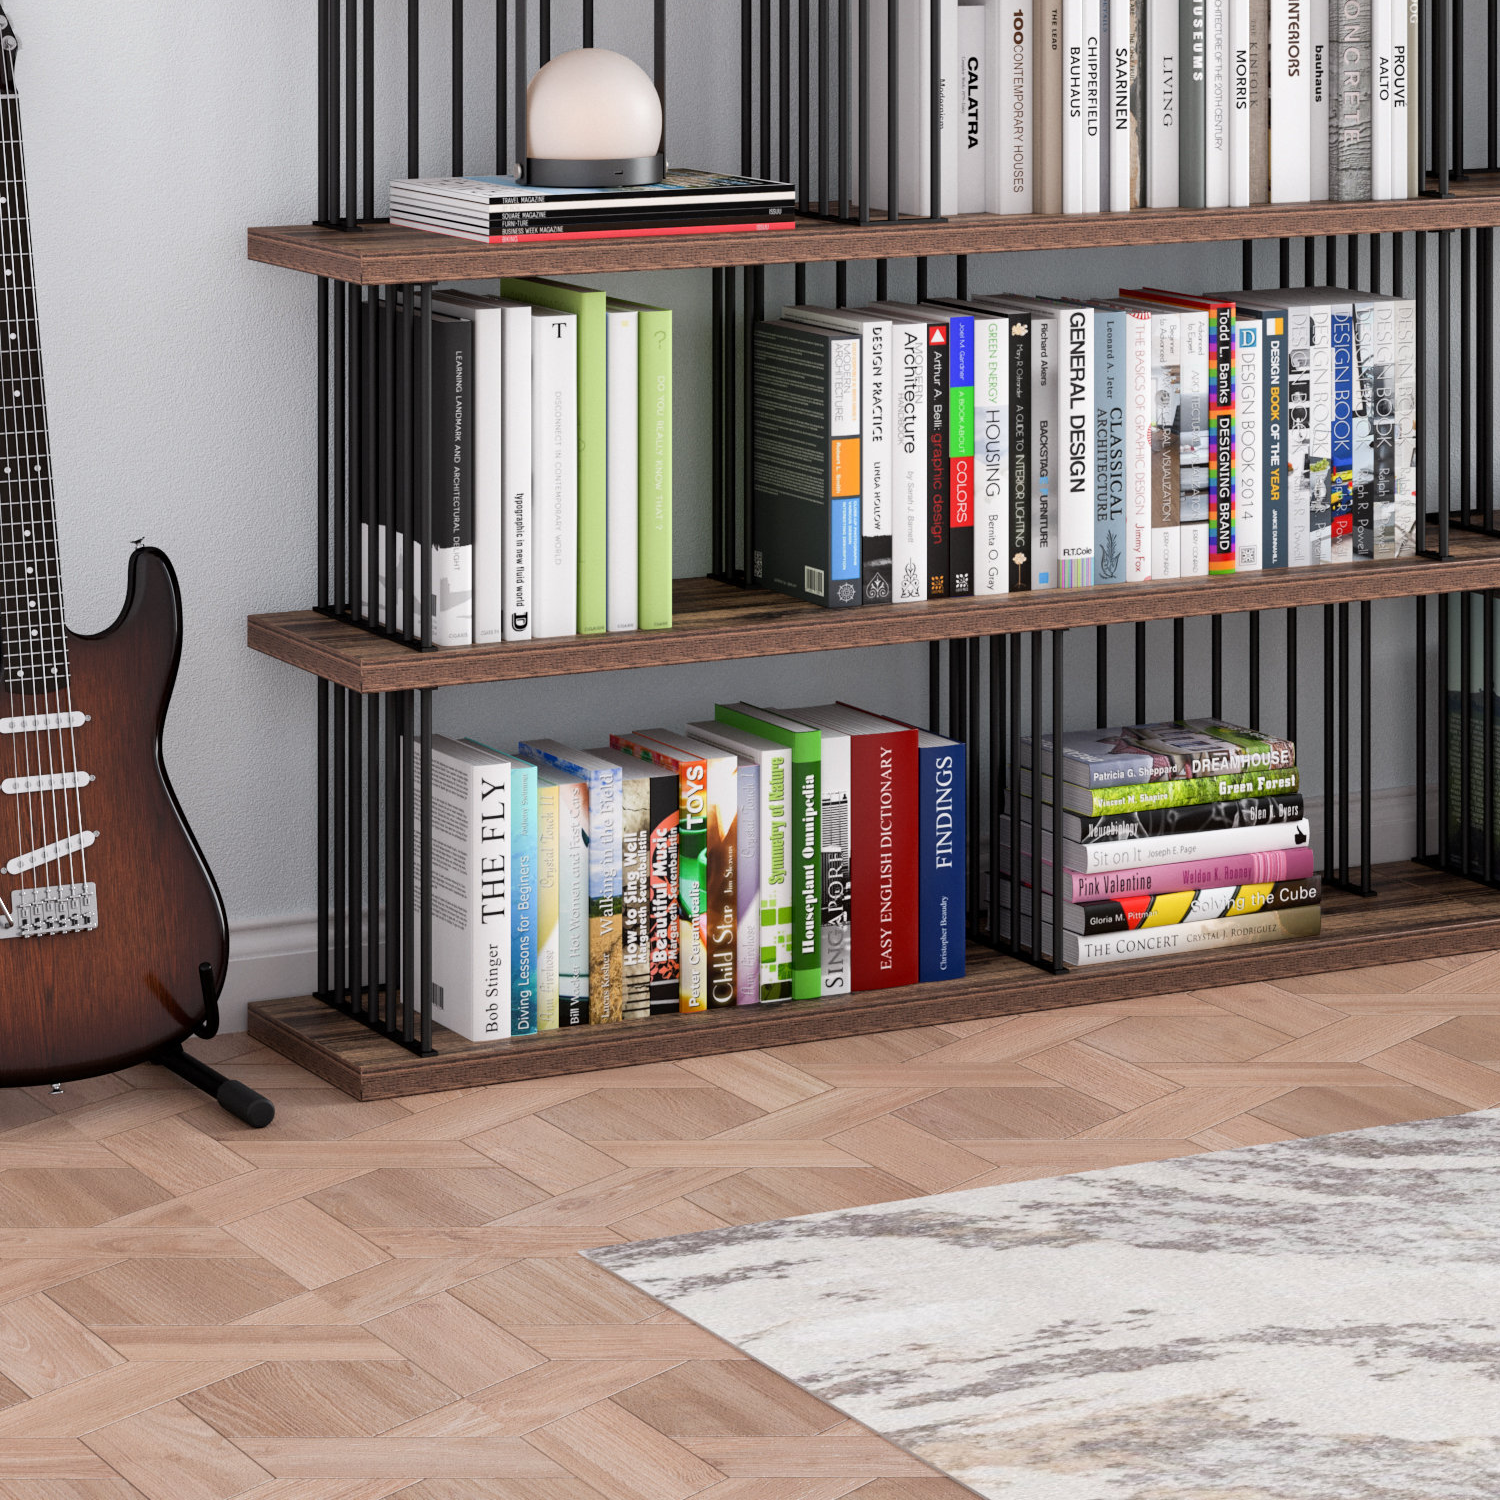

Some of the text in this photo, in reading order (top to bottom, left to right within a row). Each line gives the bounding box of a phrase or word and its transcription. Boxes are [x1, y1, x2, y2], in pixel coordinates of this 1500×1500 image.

[967, 56, 979, 149] CALATRA
[1070, 46, 1080, 118] BAUHAUS
[1087, 36, 1098, 137] CHIPPERFIELD
[1116, 48, 1128, 130] SAARINEN
[1163, 56, 1173, 127] LIVING
[1236, 50, 1247, 110] MORRIS
[1315, 45, 1324, 103] bauhaus
[1379, 56, 1389, 101] AALTO
[502, 210, 546, 220] SQUARE MAGAZINE
[521, 195, 545, 203] MAGAZINE
[1013, 145, 1024, 193] HOUSES
[502, 227, 524, 235] BUSINESS
[540, 225, 564, 233] MAGAZINE
[872, 327, 883, 442] DESIGN PRACTICE
[904, 332, 917, 454] Architecture
[988, 323, 998, 404] GREEN ENERGY
[1040, 323, 1048, 386] Richard Akers
[1334, 311, 1350, 451] DESIGN BOOK
[1376, 308, 1392, 448] DESIGN BOOK
[931, 351, 944, 544] Arthur A. Belli: graphic design
[1070, 312, 1085, 493] GENERAL DESIGN
[1219, 309, 1230, 551] Todd L. Banks DESIGNING BRAND
[1241, 353, 1255, 521] DESIGN BOOK 2014
[1270, 340, 1280, 501] DESIGN BOOK OF THE YEAR
[453, 350, 463, 571] LEARNING LANDMARK AND ARCHITECTURAL DELIGHT
[956, 460, 967, 523] COLORS
[986, 410, 1000, 497] HOUSING
[1039, 420, 1048, 548] BACKSTAGE FURNITURE
[1097, 408, 1108, 521] ARCHITECTURE
[1110, 407, 1123, 521] CLASSICAL
[515, 493, 524, 608] typographic in new fluid world
[687, 765, 705, 830] TOYS
[1093, 765, 1178, 782] Patricia G. Sheppard
[1192, 750, 1289, 774] DREAMHOUSE
[1219, 774, 1296, 795] Green Forest
[482, 778, 505, 924] THE FLY
[600, 773, 616, 936] Walking in the Field
[769, 756, 787, 885] Symmetry of Nature
[880, 746, 893, 971] EASY ENGLISH DICTIONARY
[936, 755, 953, 870] FINDINGS
[1088, 821, 1139, 838] Neurobiology
[1093, 848, 1142, 867] Sit on It
[1148, 844, 1197, 861] Joseph E. Page
[623, 832, 640, 966] How to Sing Well
[653, 827, 668, 963] Beautiful Music
[802, 774, 818, 954] Houseplant Omnipedia
[1079, 873, 1152, 896] Pink Valentine
[1191, 886, 1317, 914] Solving the Cube
[517, 855, 532, 1030] Diving Lessons for Beginers
[689, 881, 700, 1007] Peter Ceramicalis
[713, 905, 733, 1004] Child Star
[825, 852, 845, 988] SINGAPORE
[940, 895, 950, 971] Christopher Beaudry
[1085, 934, 1179, 958] THE CONCERT
[1090, 910, 1158, 926] Gloria M. Pittman
[485, 943, 501, 1033] Bob Stinger
